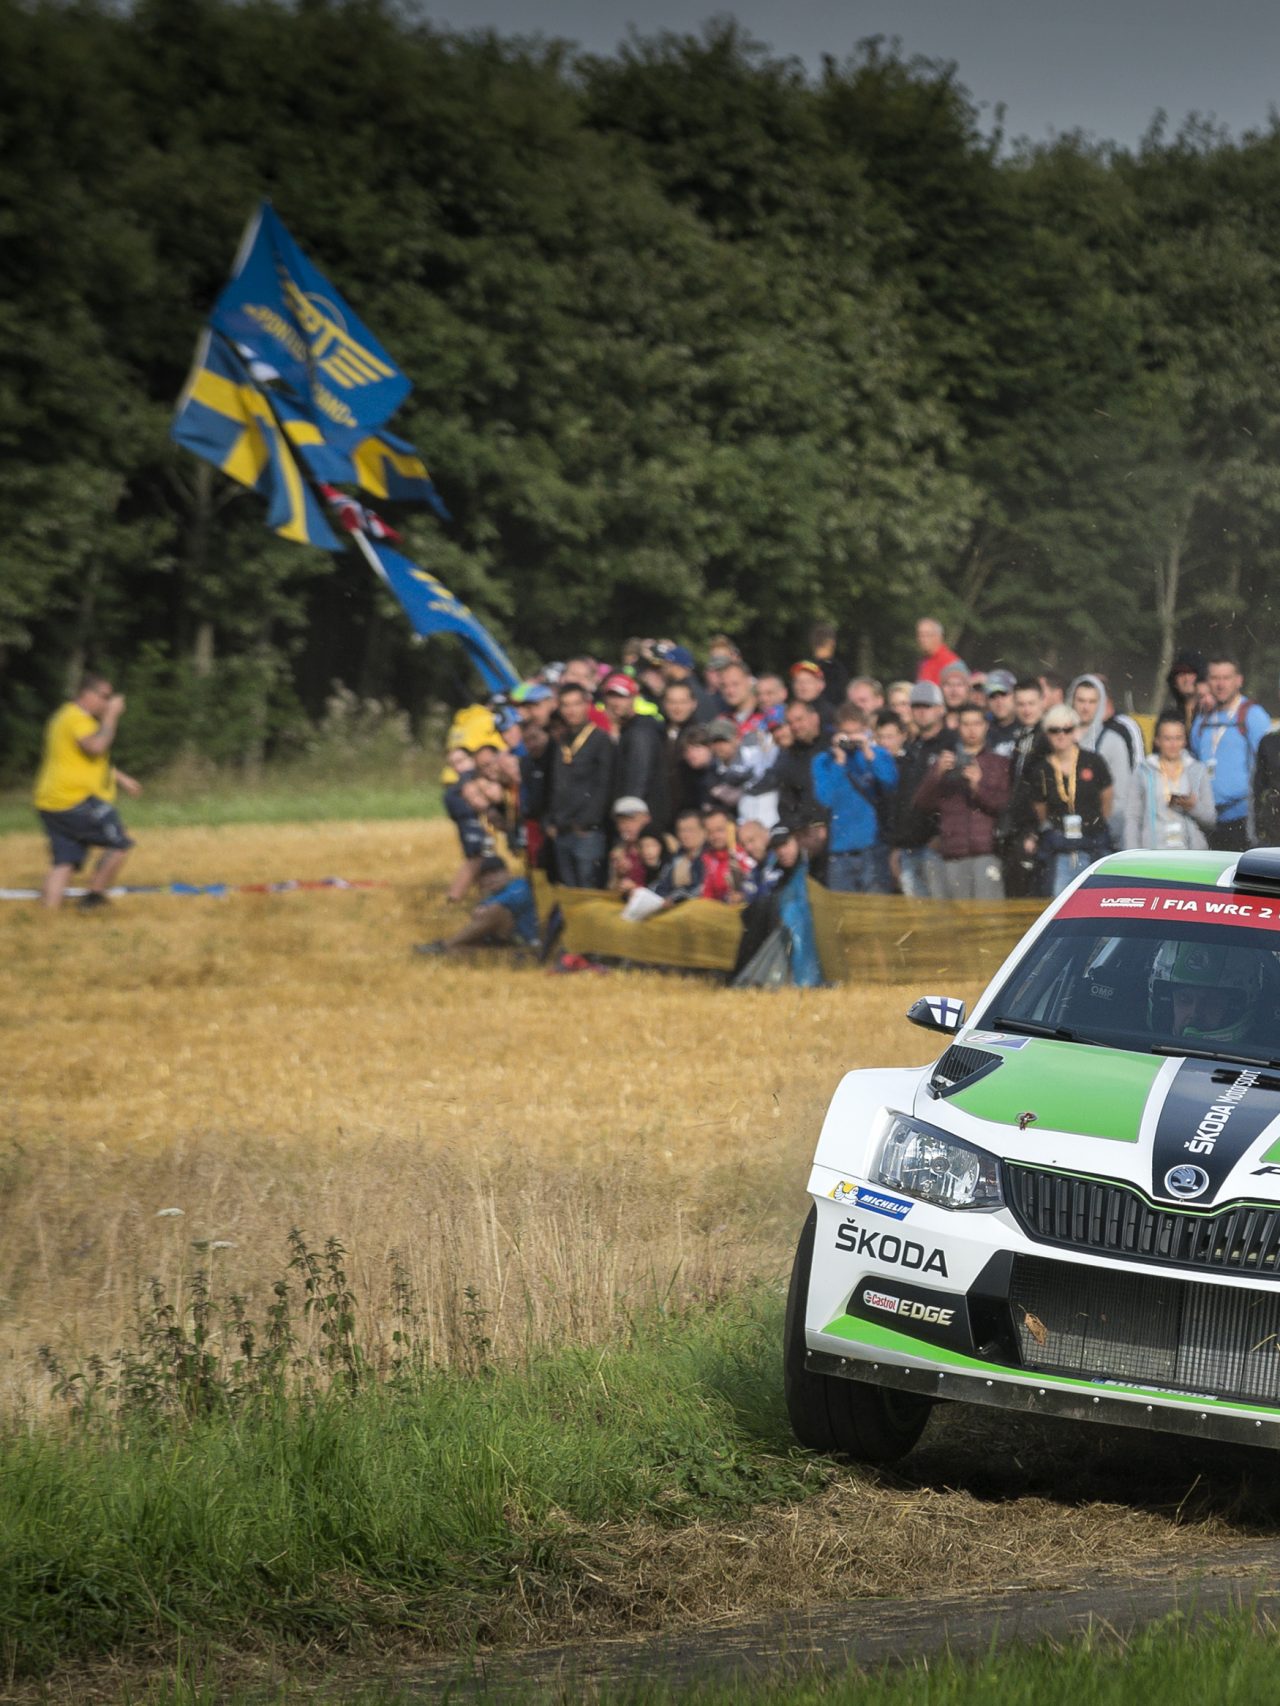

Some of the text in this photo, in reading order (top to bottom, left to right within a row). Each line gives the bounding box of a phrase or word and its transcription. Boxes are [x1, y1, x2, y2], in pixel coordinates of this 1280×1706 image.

[1163, 899, 1198, 911] FIA
[1205, 902, 1253, 916] WRC
[1258, 907, 1272, 919] 2
[1184, 1098, 1236, 1155] ŠKODA
[1218, 1069, 1262, 1105] Motorsport
[861, 1195, 911, 1214] MICHELIN
[835, 1217, 948, 1278] ŠKODA
[872, 1294, 956, 1326] Castrol EDGE
